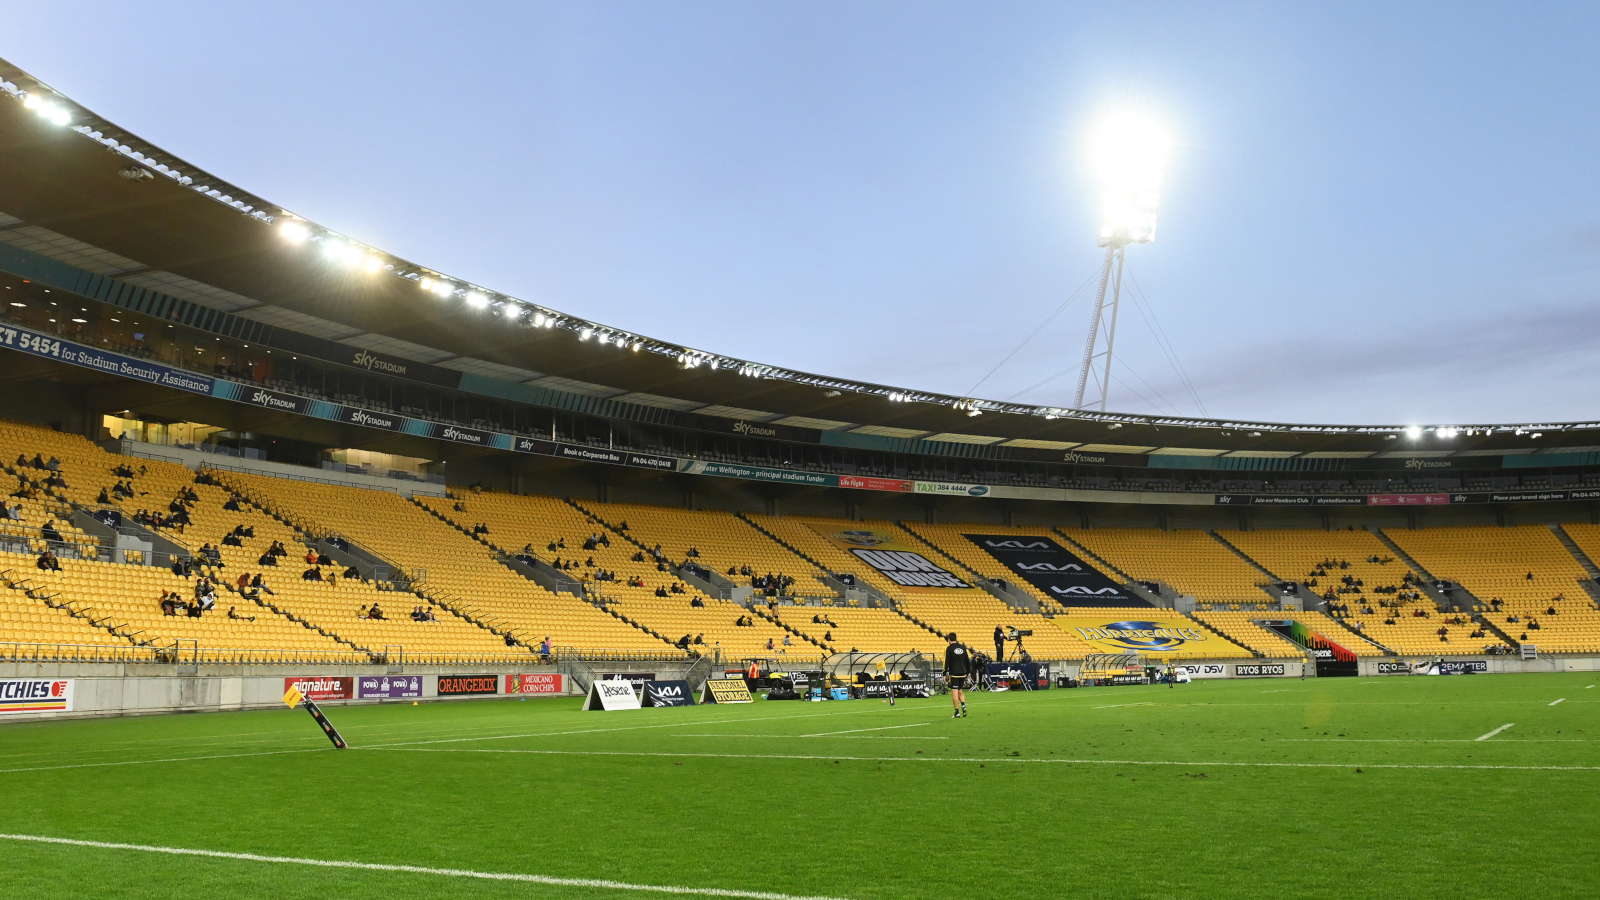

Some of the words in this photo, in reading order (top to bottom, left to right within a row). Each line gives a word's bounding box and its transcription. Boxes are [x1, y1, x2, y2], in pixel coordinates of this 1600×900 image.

[19, 333, 60, 356] 5454
[61, 348, 76, 361] for
[78, 352, 118, 371] Stadium
[120, 362, 160, 383] Security
[162, 372, 210, 392] Assistance
[353, 350, 377, 370] sky
[374, 360, 406, 374] STADIUM
[252, 390, 271, 406] sky
[270, 398, 295, 410] STADIUM
[351, 410, 369, 426] sky
[367, 417, 391, 427] STADIUM
[443, 427, 460, 440] sky
[458, 434, 480, 442] STADIUM
[733, 420, 751, 435] sky
[750, 427, 776, 436] STADIUM
[520, 440, 534, 450] sky
[564, 448, 577, 456] Book
[582, 451, 608, 460] Corporate
[1064, 451, 1081, 463] sky
[696, 464, 718, 472] Greater
[719, 466, 750, 476] Wellington
[756, 470, 781, 479] principal
[917, 483, 936, 492] TAXI
[851, 549, 948, 572] OUR
[880, 570, 971, 588] HOUSE
[1076, 627, 1206, 640] HURRICANES
[1238, 666, 1259, 674] RYOS
[1262, 666, 1283, 674] RYOS
[0, 682, 50, 698] TCHIES
[438, 678, 497, 692] ORANGEBOX
[715, 692, 750, 700] STORAGE
